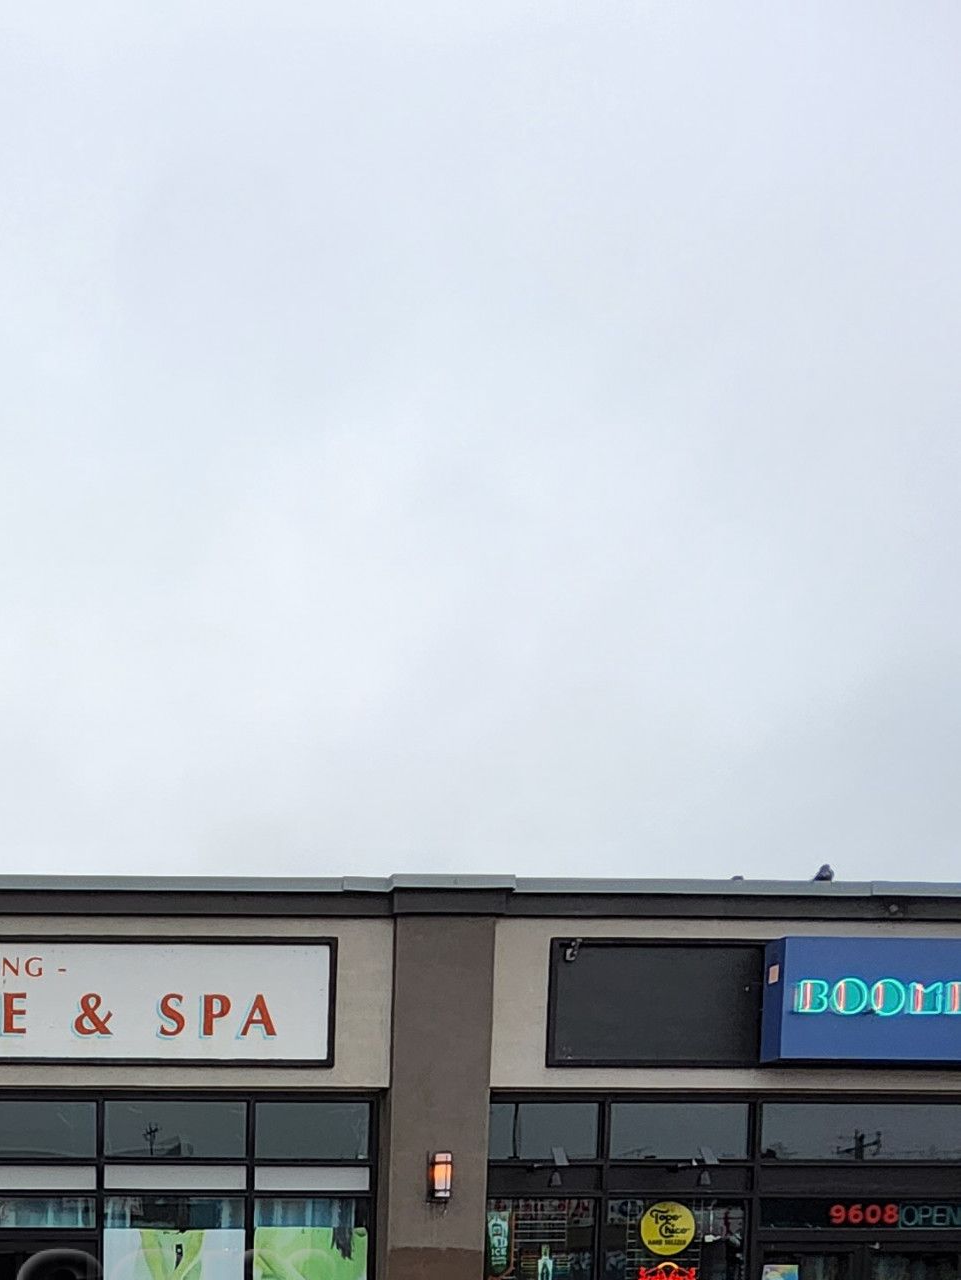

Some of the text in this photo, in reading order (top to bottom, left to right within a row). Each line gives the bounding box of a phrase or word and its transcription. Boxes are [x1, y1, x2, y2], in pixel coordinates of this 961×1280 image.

[71, 993, 114, 1038] &
[156, 993, 278, 1040] SPA
[829, 1203, 899, 1224] 9608
[902, 1204, 961, 1226] OPEN
[659, 1223, 691, 1239] Chico
